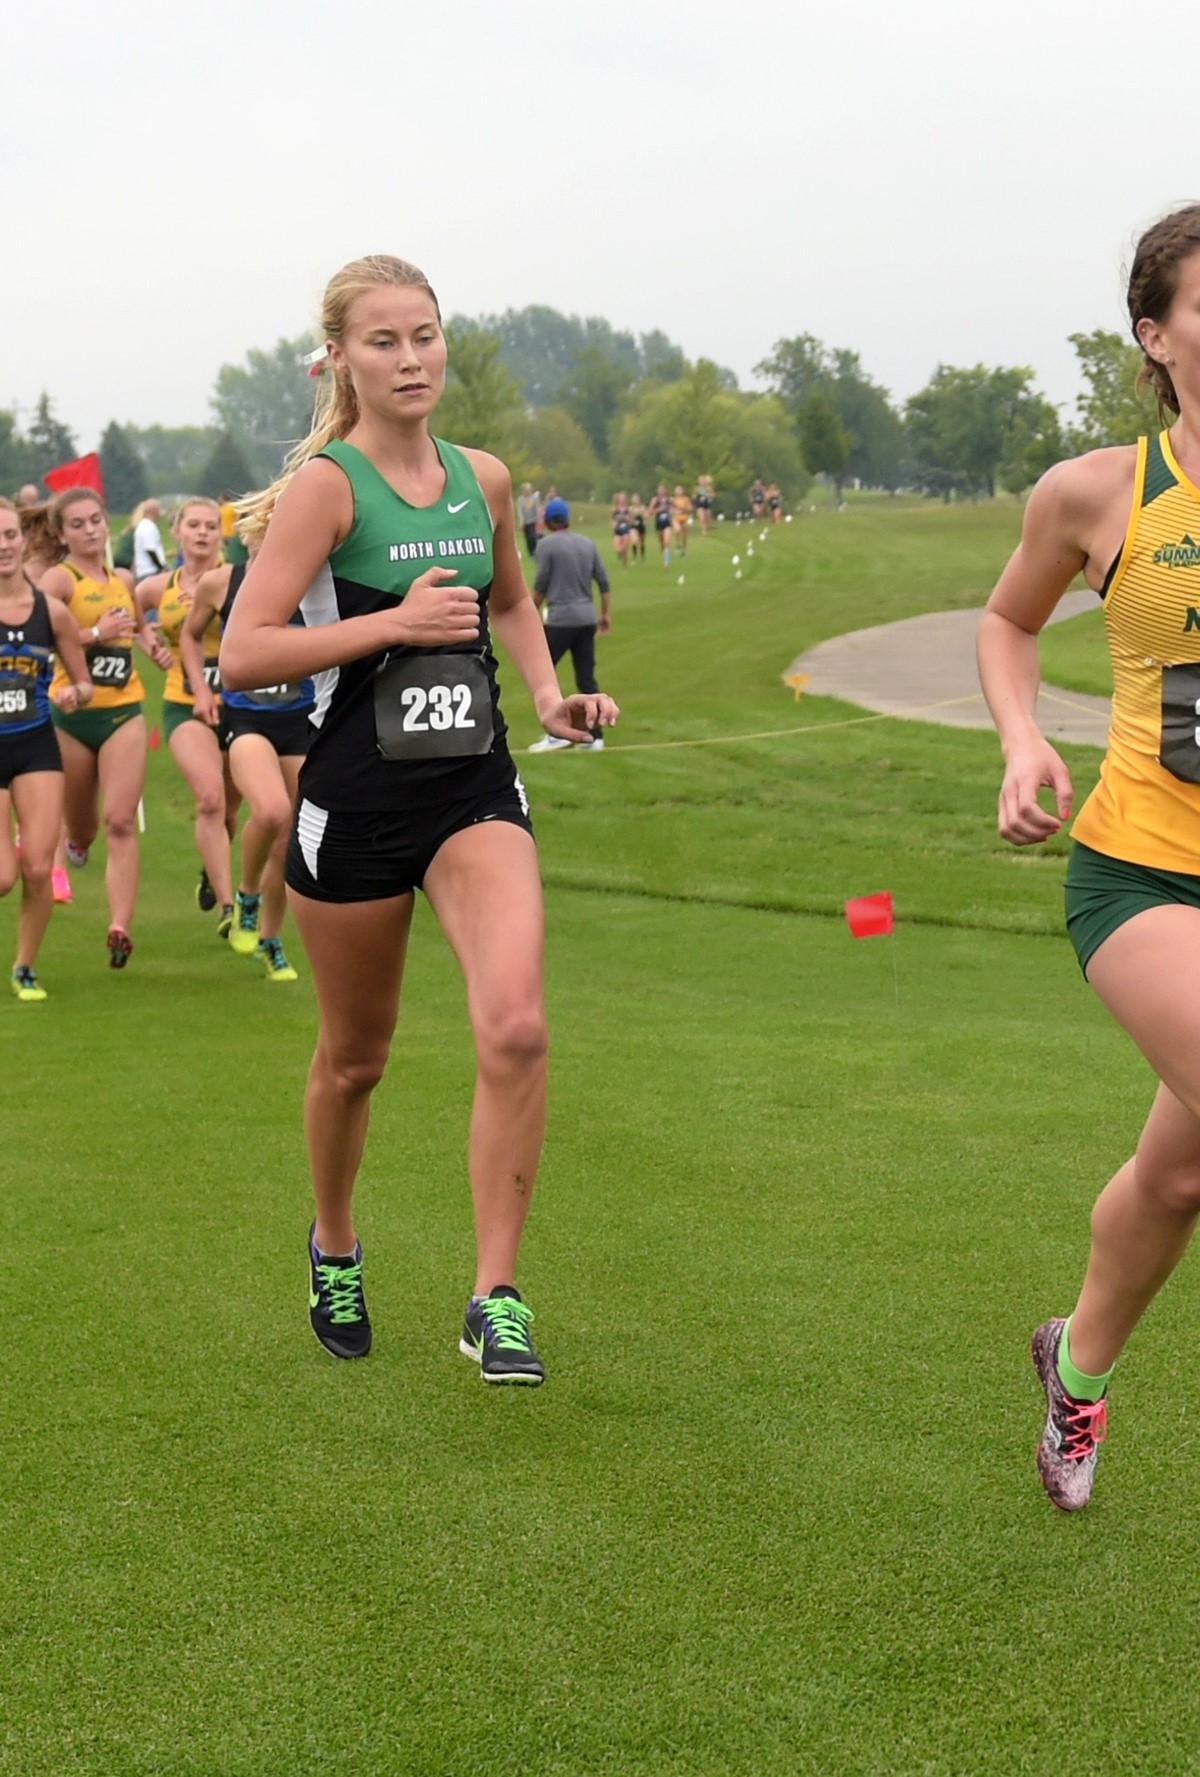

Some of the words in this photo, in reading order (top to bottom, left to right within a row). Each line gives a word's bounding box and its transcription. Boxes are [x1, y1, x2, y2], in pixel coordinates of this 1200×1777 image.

[389, 541, 434, 561] NORTH
[438, 537, 485, 557] DAKOTA
[91, 655, 126, 679] 272
[401, 683, 476, 733] 232
